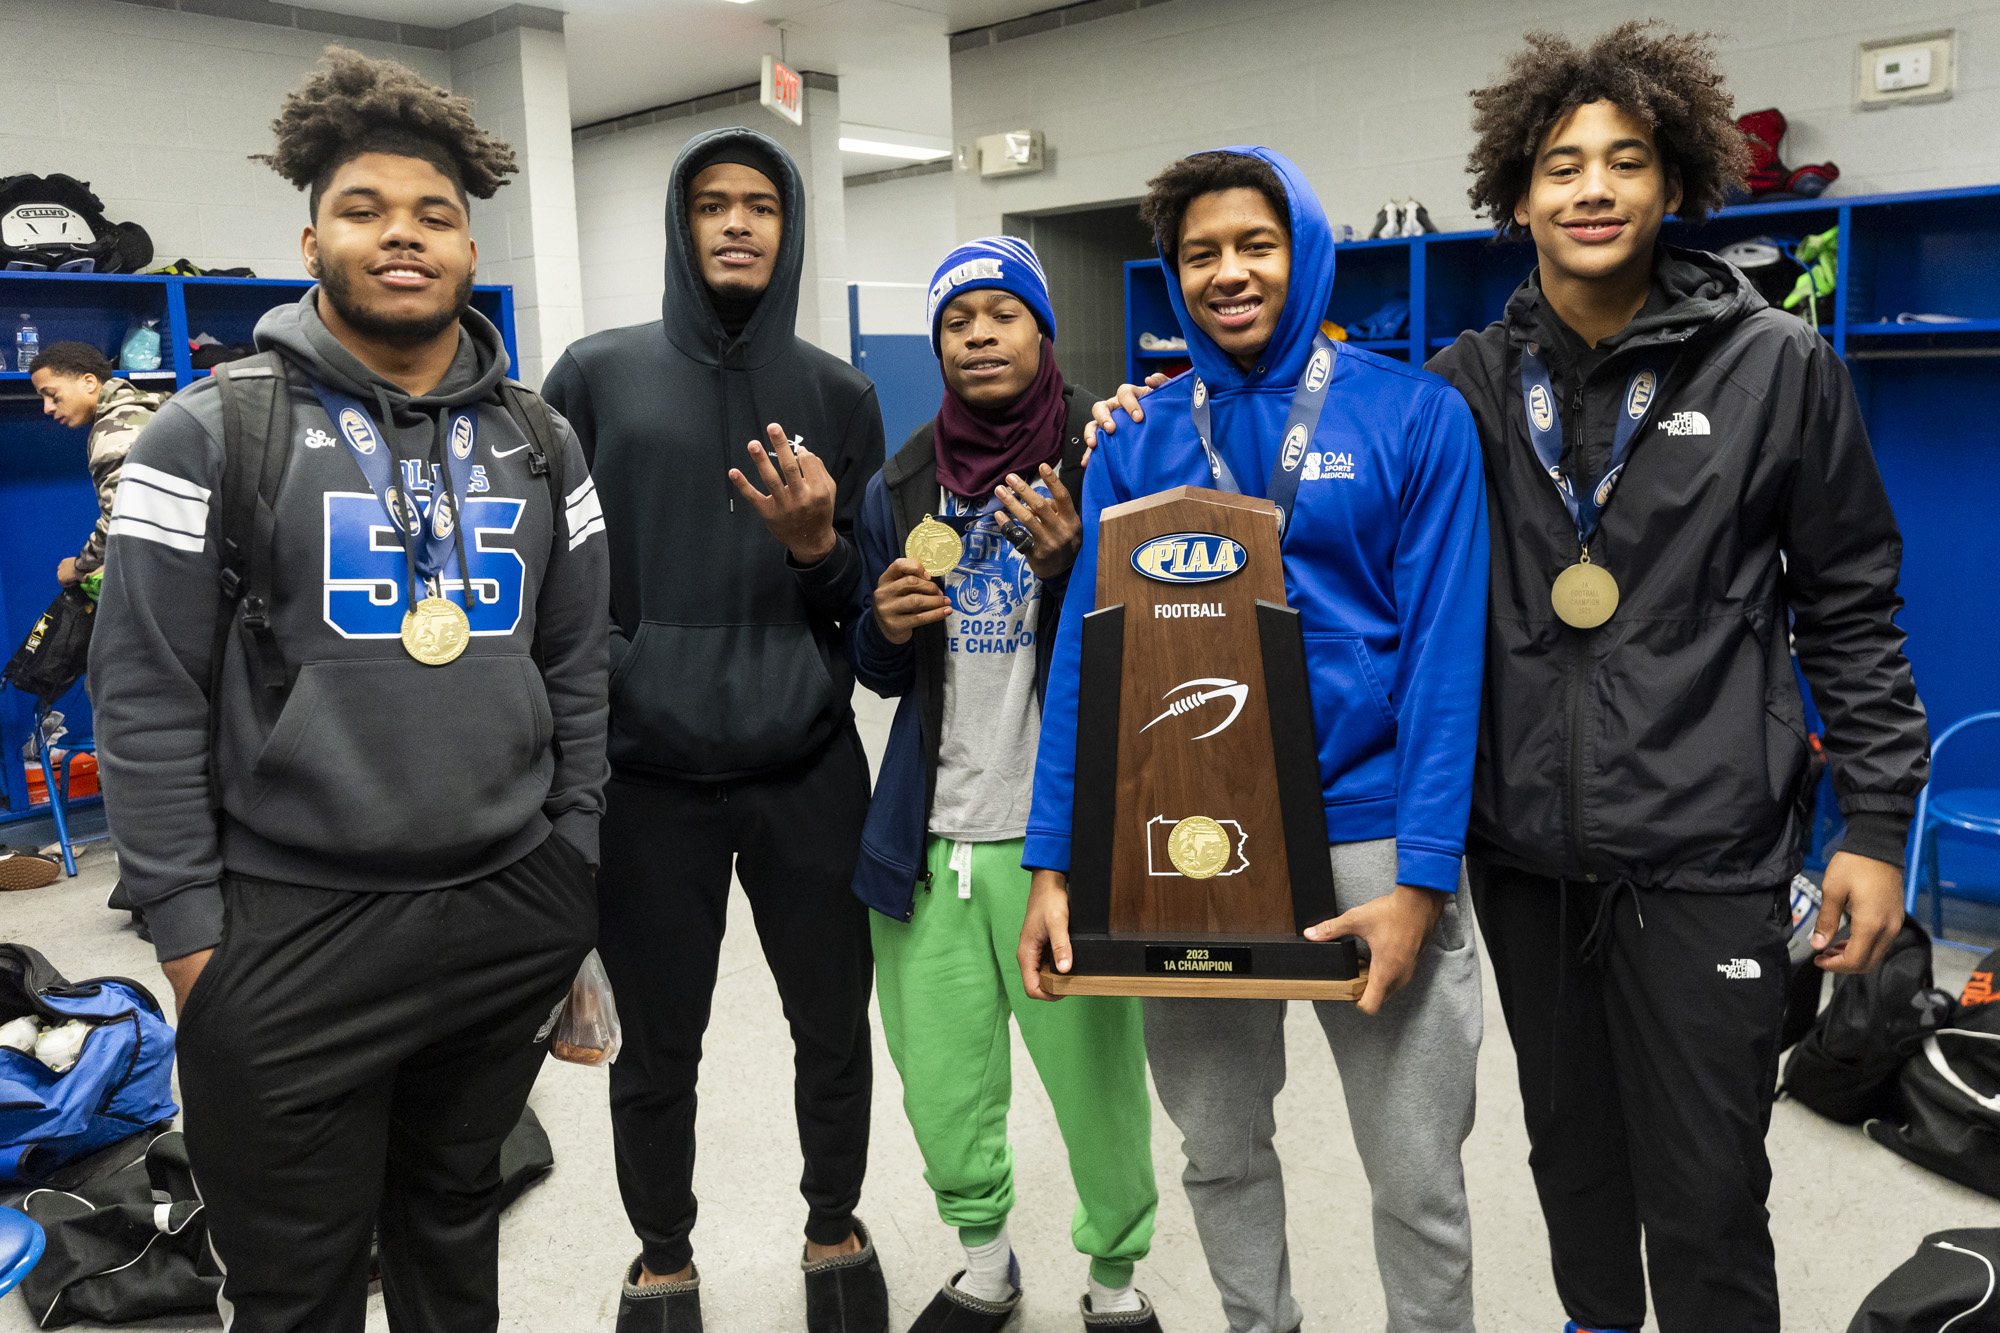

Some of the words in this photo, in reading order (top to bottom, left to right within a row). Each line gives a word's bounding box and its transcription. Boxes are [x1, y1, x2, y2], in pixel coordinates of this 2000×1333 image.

[775, 62, 800, 113] EXIT
[21, 209, 65, 217] BATTLE
[1307, 349, 1329, 391] PIAA
[1631, 371, 1654, 417] PIAA
[1531, 386, 1551, 430] PIAA
[1672, 411, 1693, 421] THE
[342, 411, 375, 453] PIAA
[1657, 419, 1693, 430] NORTH
[1667, 427, 1693, 436] FACE
[454, 418, 472, 458] PIAA
[1284, 425, 1307, 470] PIAA
[1323, 451, 1355, 466] OAL
[1324, 464, 1351, 472] SPORTS
[1319, 472, 1355, 480] MEDICINE
[1148, 541, 1238, 573] PIAA
[323, 491, 527, 639] 55
[1154, 602, 1226, 619] FOOTBALL
[960, 620, 1006, 636] 2022
[1186, 949, 1209, 960] 2023
[1730, 958, 1747, 966] THE
[1163, 960, 1177, 971] 1A
[1177, 960, 1233, 972] CHAMPION
[1717, 963, 1747, 972] NORTH
[1726, 971, 1747, 979] FACE
